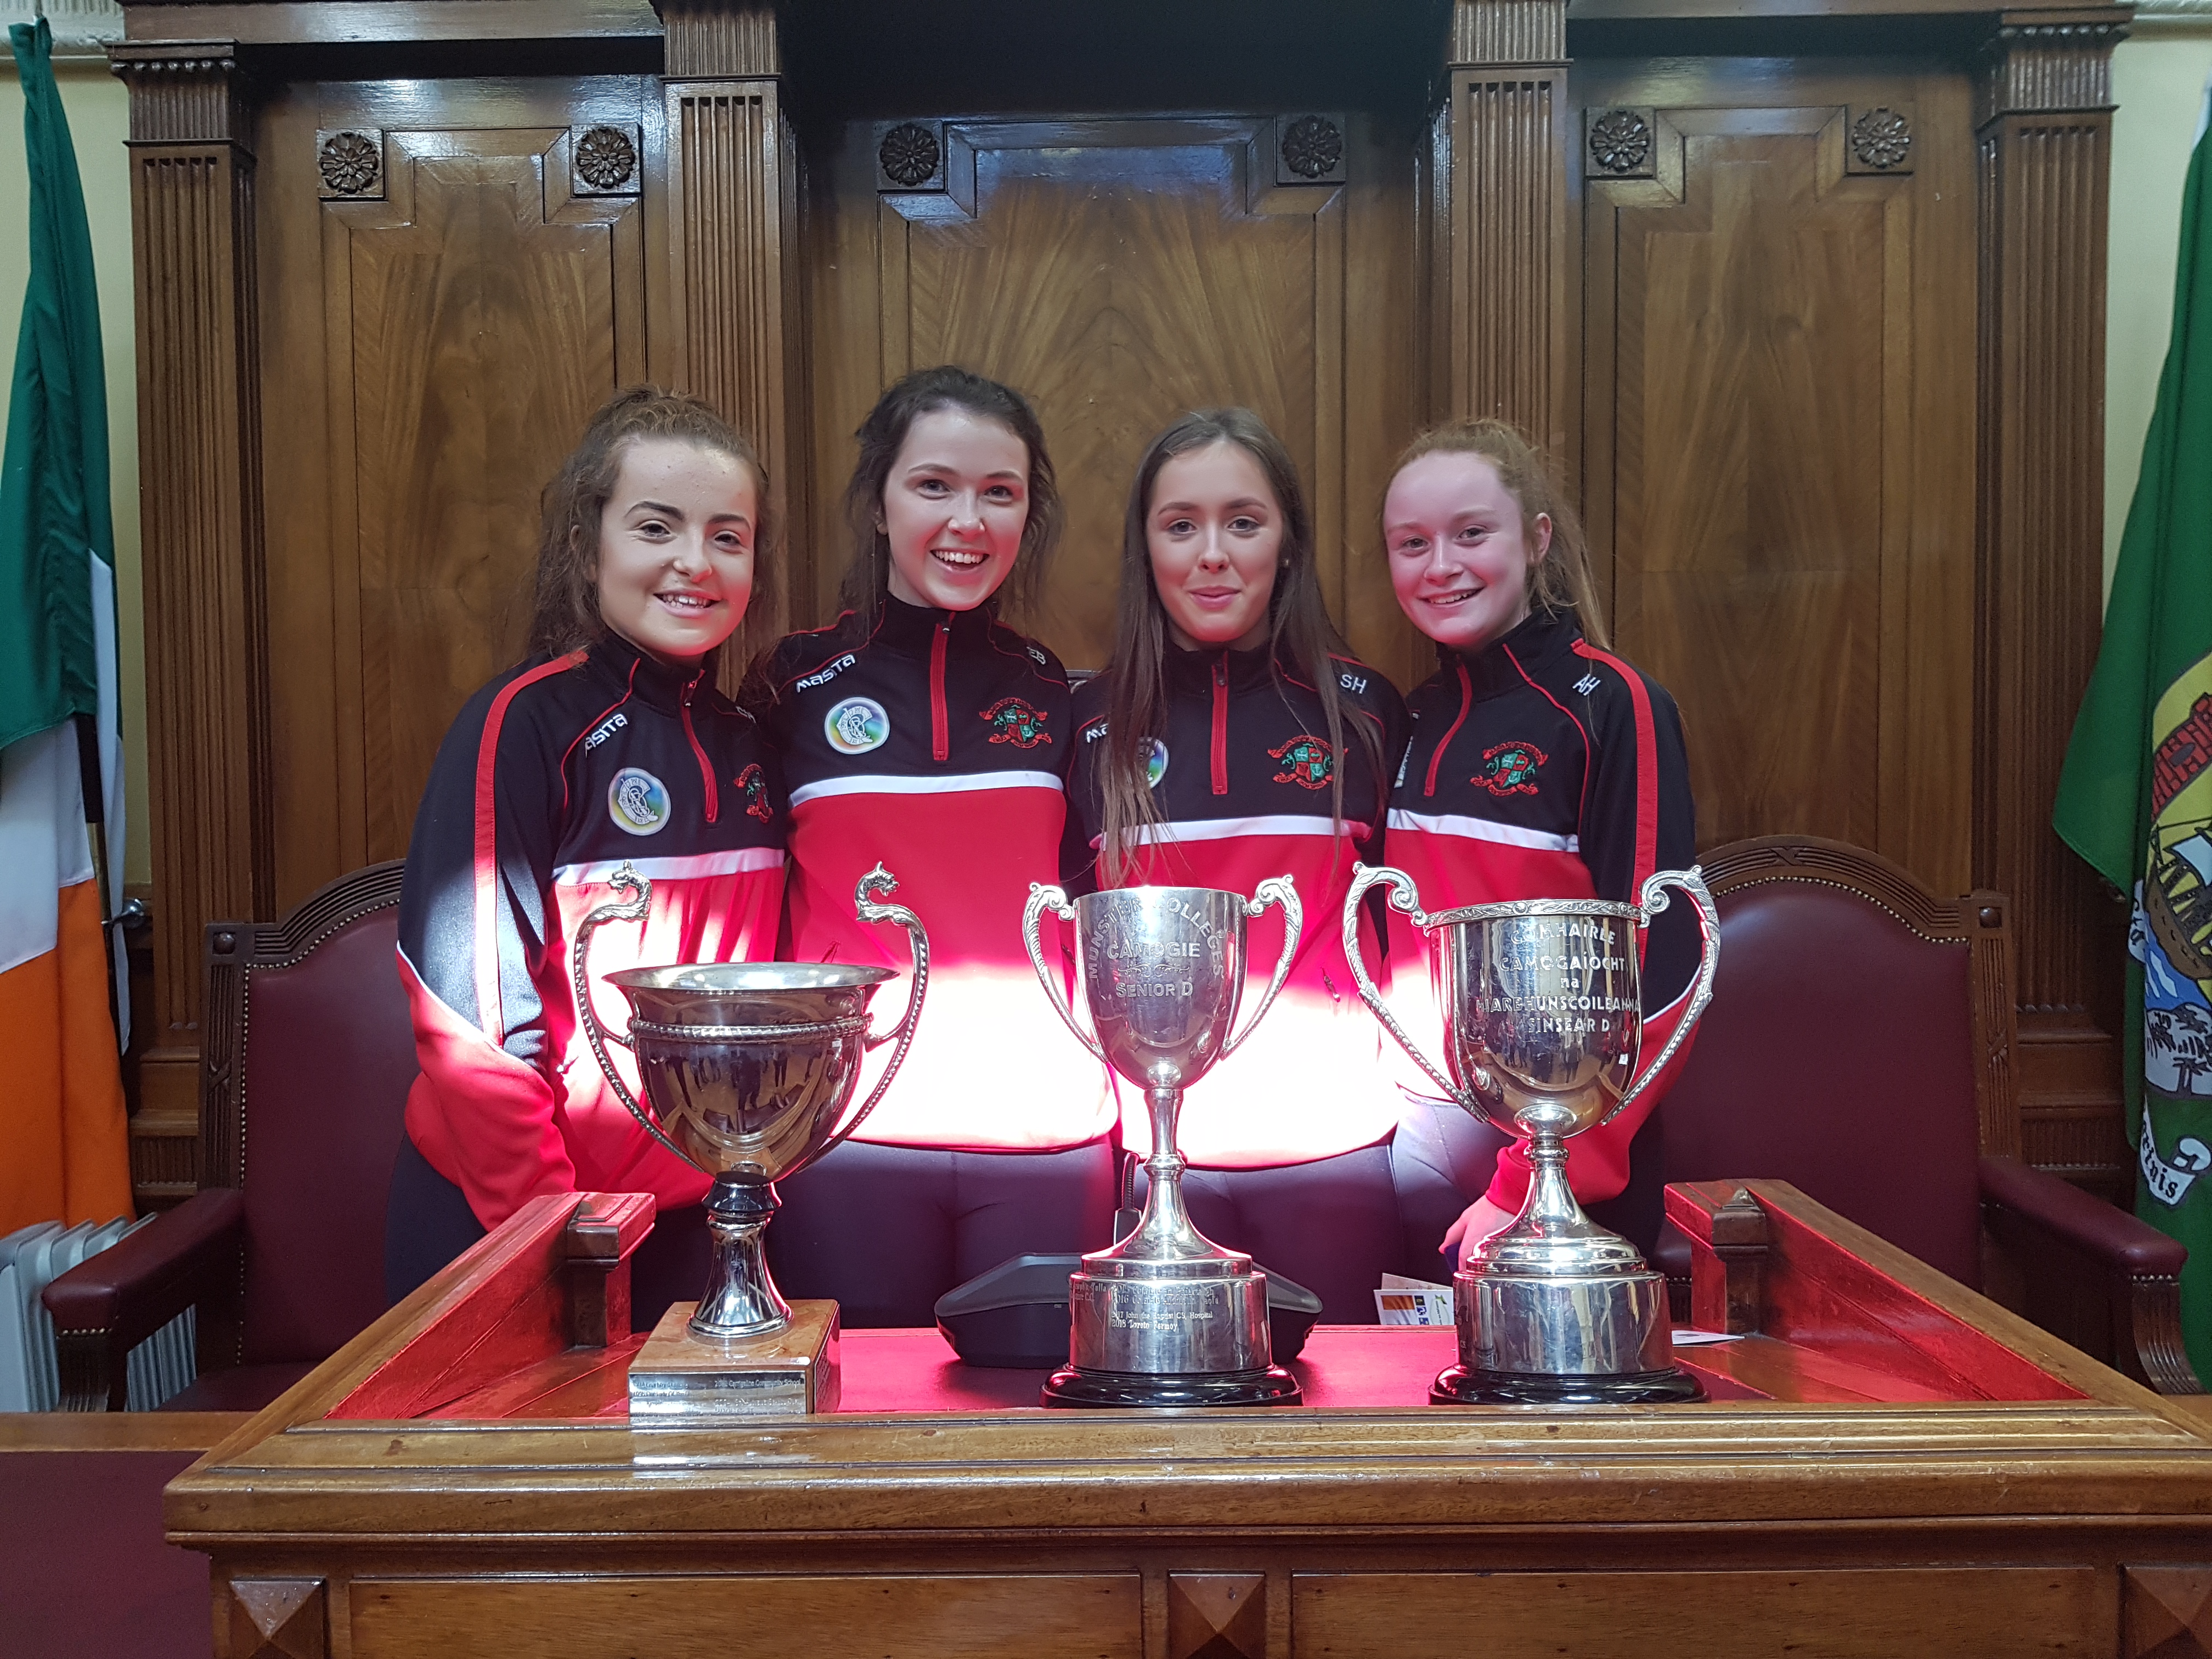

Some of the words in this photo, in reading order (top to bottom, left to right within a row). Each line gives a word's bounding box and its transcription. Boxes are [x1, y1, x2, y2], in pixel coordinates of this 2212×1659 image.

[1340, 674, 1367, 694] SH
[1572, 673, 1601, 696] AH
[1088, 896, 1143, 979] MUNSTER
[1107, 942, 1201, 960] CAMOGIE
[1115, 983, 1175, 998] SENIOR
[1182, 981, 1193, 997] D
[1560, 977, 1579, 988] na
[1601, 1018, 1610, 1032] D
[1126, 1311, 1139, 1319] John
[1189, 1311, 1213, 1319] Hospital
[1111, 1318, 1126, 1328] 2018
[1153, 1319, 1178, 1332] Fermoy
